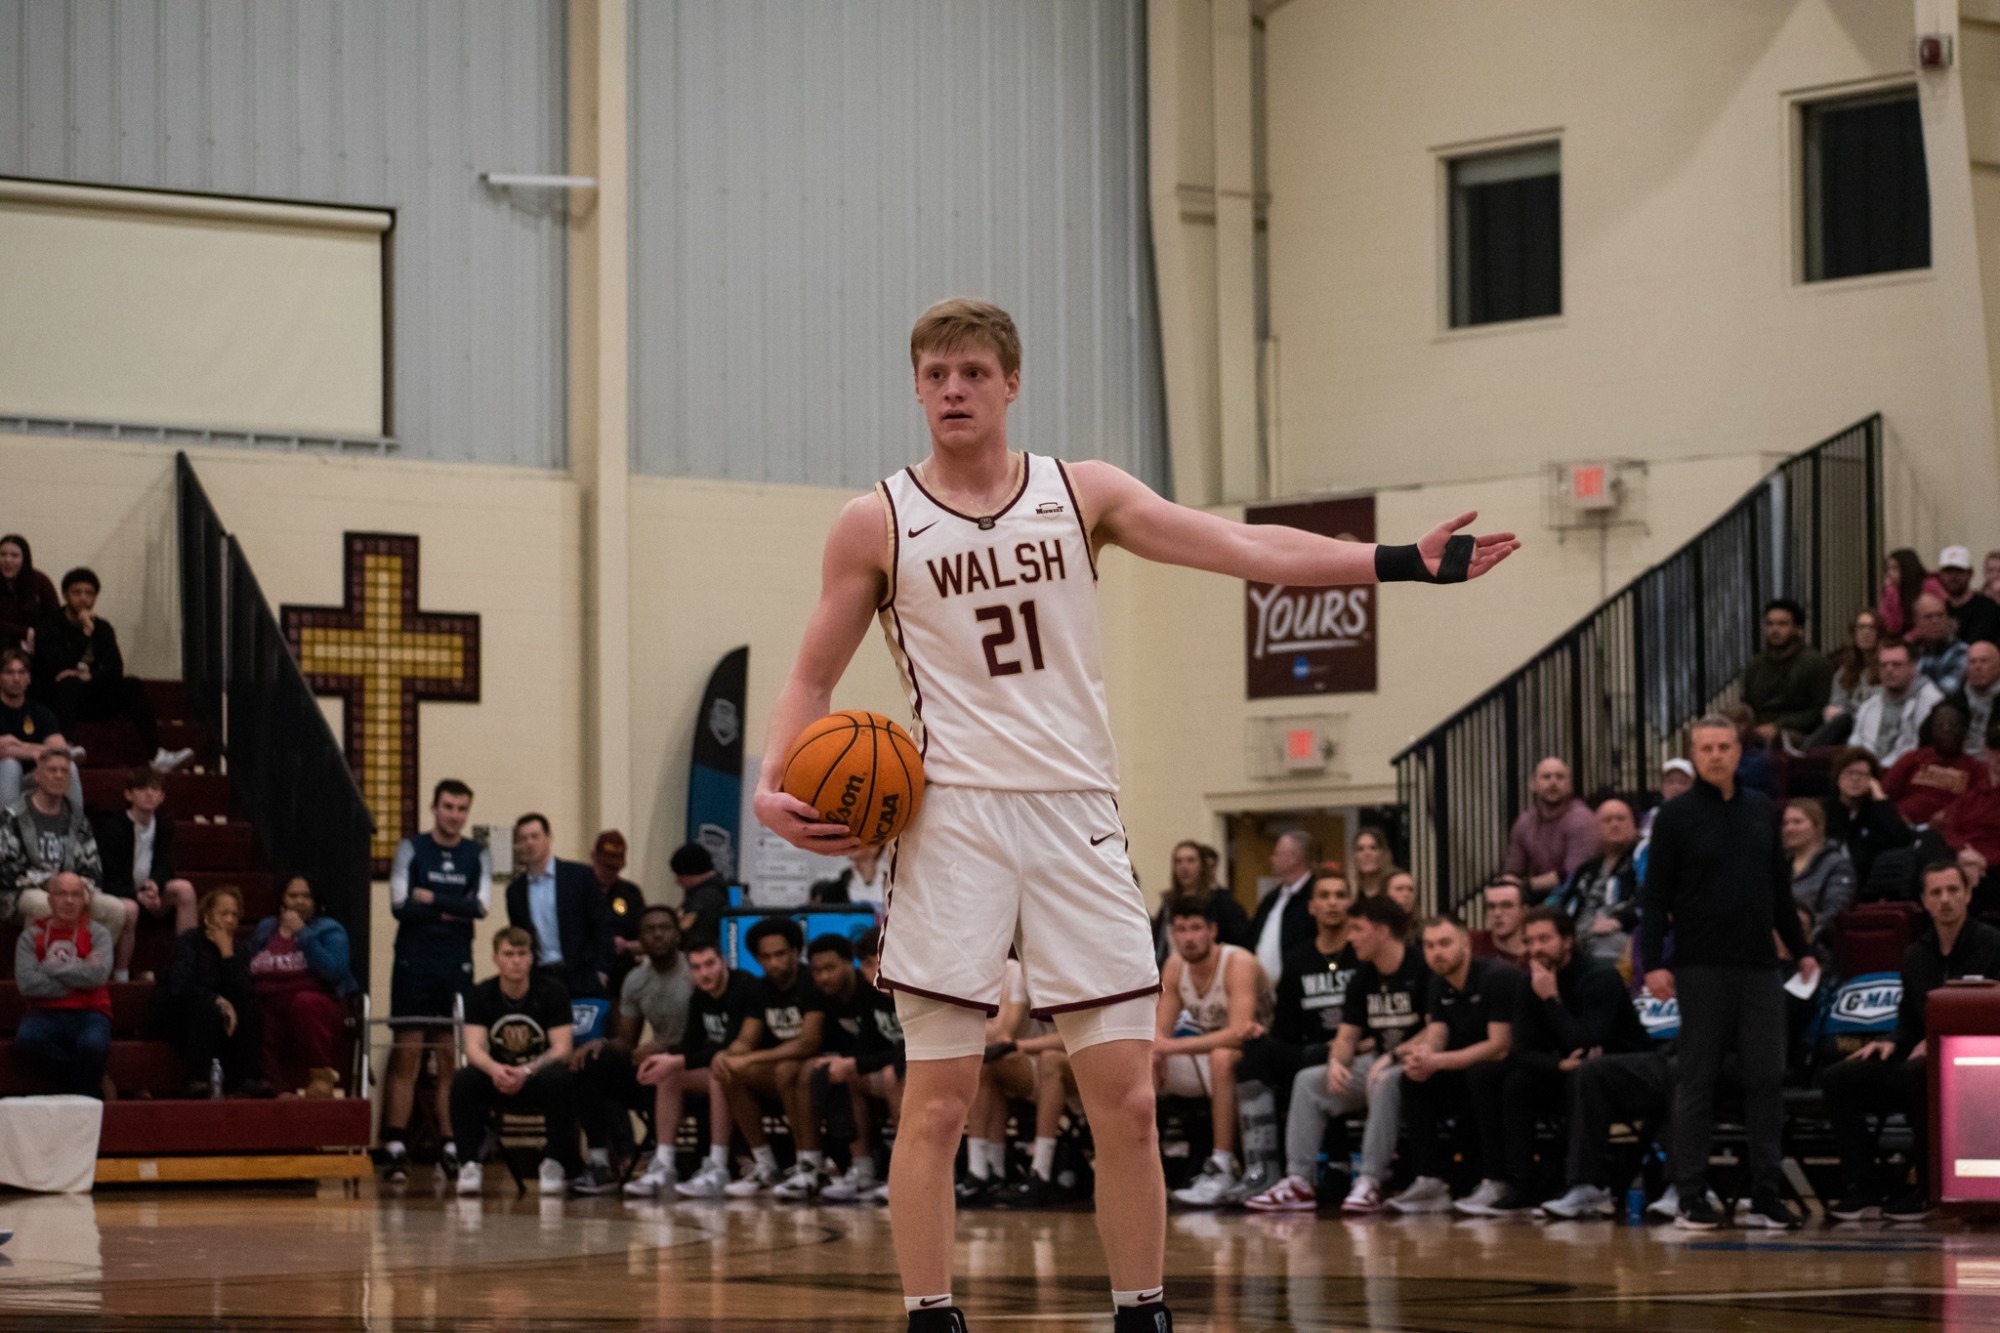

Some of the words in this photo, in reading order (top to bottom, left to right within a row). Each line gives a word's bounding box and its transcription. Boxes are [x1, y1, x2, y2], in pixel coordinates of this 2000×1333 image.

[926, 539, 1066, 598] WALSH
[976, 600, 1045, 677] 21
[1249, 584, 1369, 659] YOURS
[825, 774, 865, 825] lson
